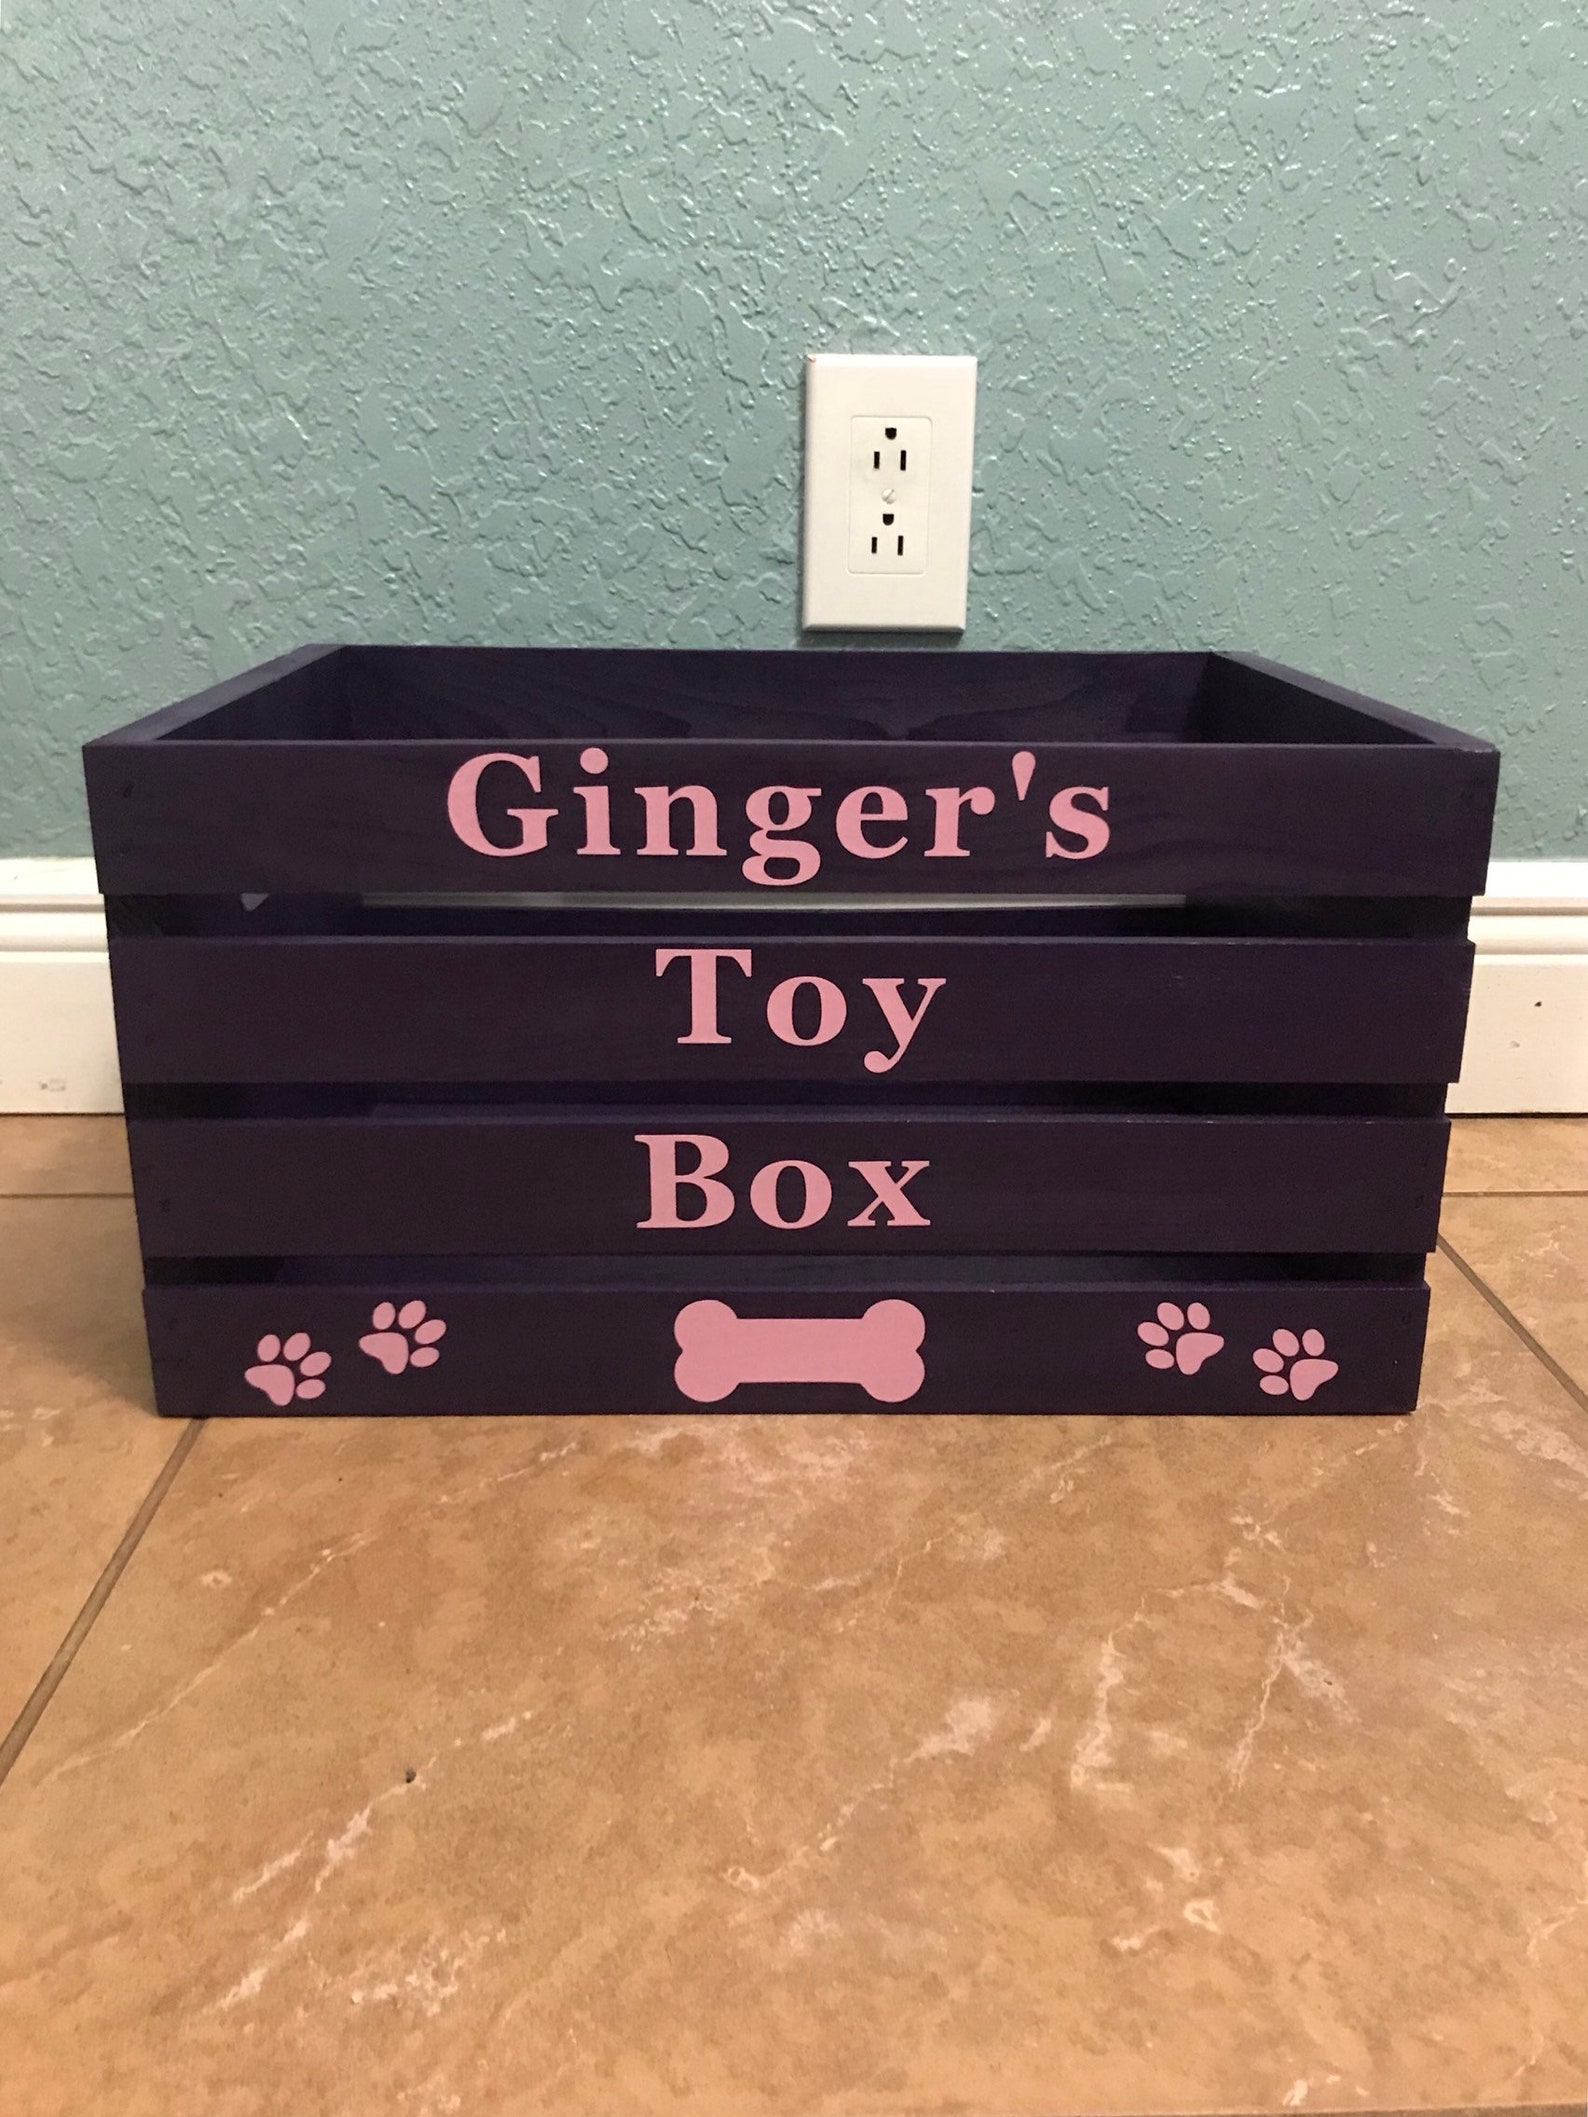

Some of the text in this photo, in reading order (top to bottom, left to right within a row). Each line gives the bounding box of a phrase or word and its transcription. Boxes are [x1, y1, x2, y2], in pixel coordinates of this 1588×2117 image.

[447, 748, 1110, 886] Ginger's
[655, 948, 947, 1073] Toy
[635, 1134, 931, 1229] Box
